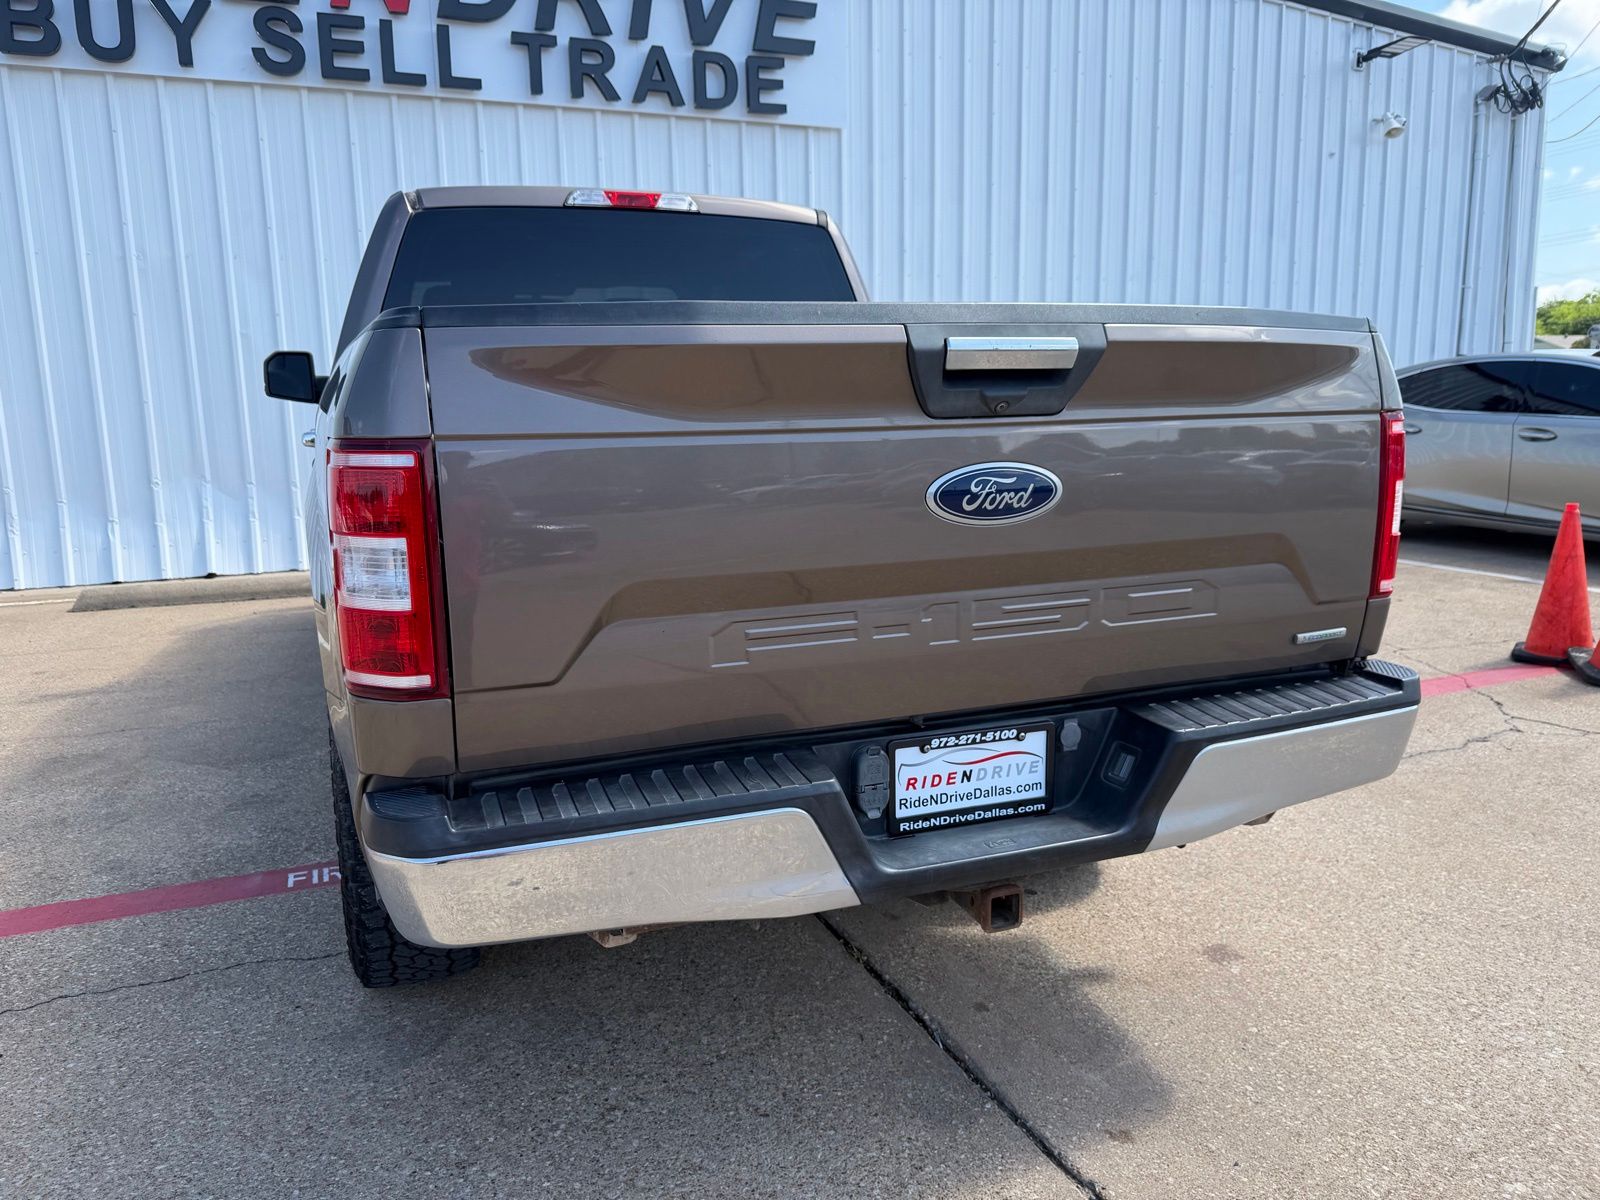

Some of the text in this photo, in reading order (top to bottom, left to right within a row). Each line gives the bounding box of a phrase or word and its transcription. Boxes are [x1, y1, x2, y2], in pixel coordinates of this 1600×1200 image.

[0, 0, 788, 114] BUY SELL TRADE
[962, 476, 1035, 512] Ford
[708, 578, 1219, 669] F-150
[930, 728, 1018, 749] 972-271-5100
[899, 780, 1043, 811] RideNDriveDallas.com
[899, 802, 1046, 832] RideNDriveDallas.com
